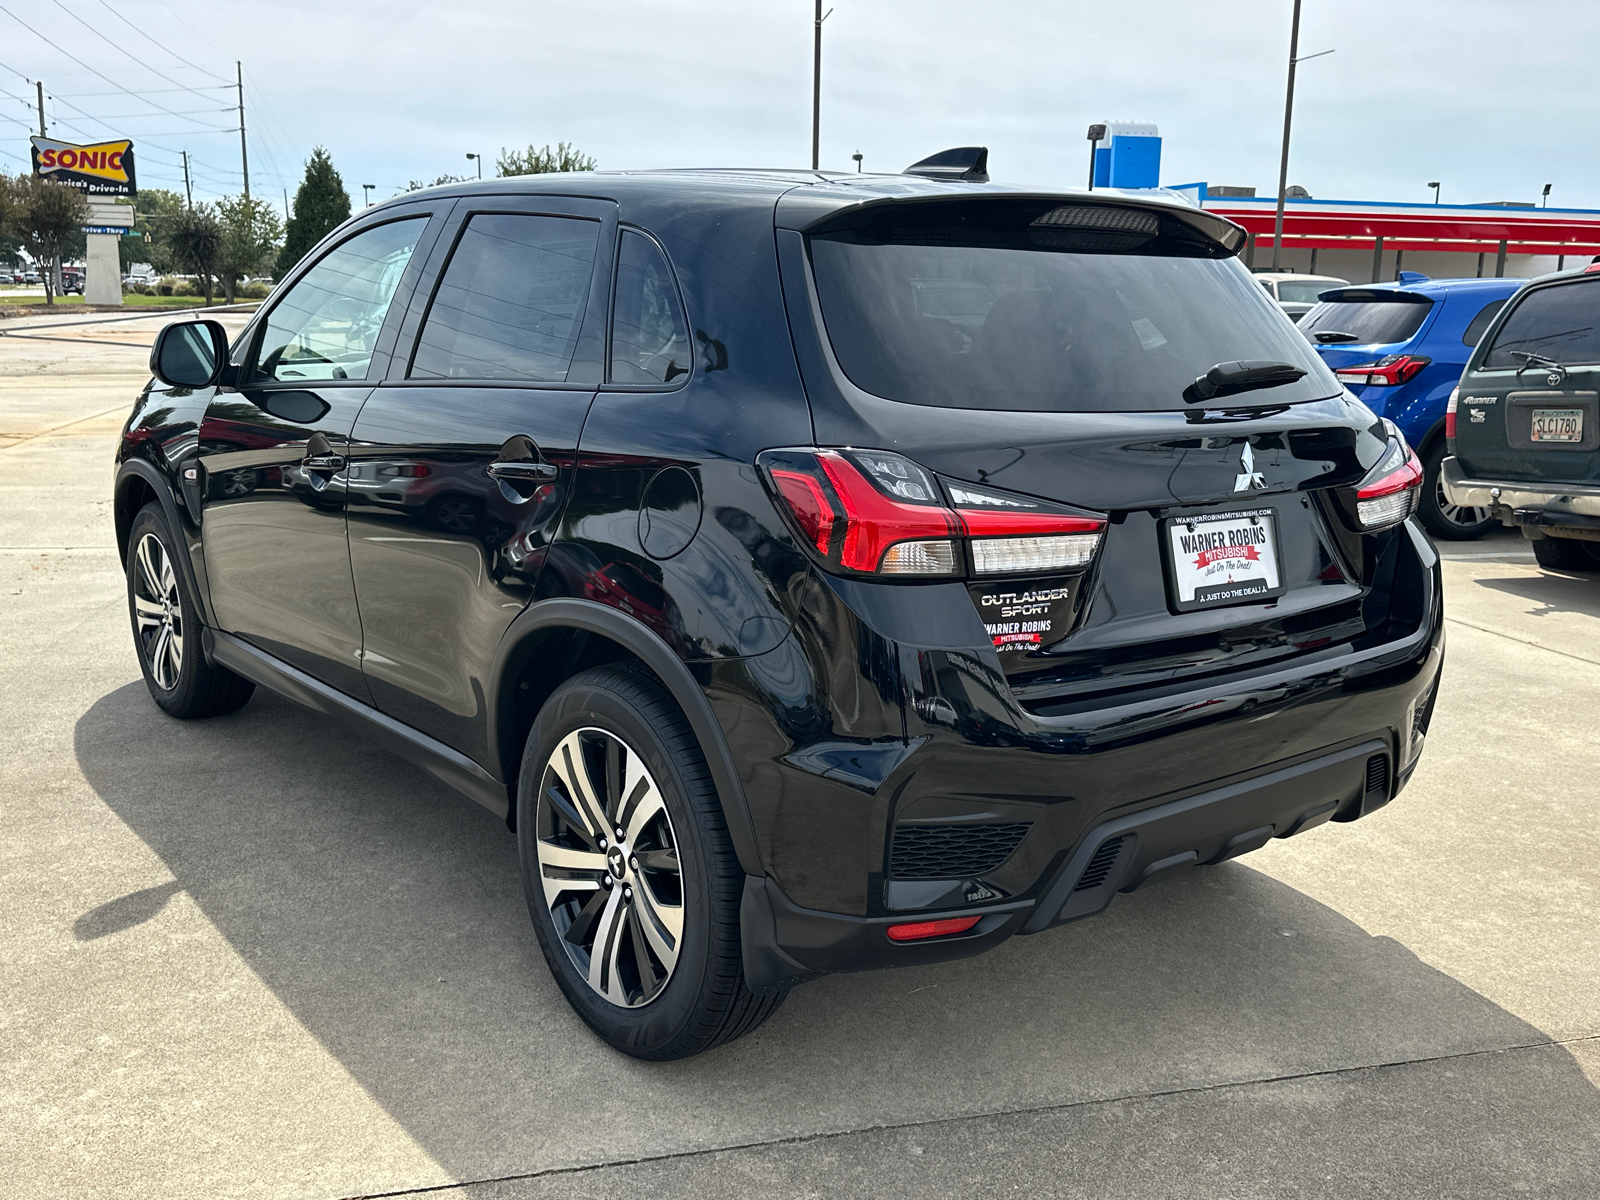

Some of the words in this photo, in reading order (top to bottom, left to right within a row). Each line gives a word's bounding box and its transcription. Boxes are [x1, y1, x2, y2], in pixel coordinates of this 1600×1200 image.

[41, 148, 124, 170] SONIC
[42, 178, 88, 188] Aerica's
[1536, 418, 1577, 434] SLC1780
[1180, 531, 1226, 554] WARNER
[1228, 526, 1266, 547] ROBINS
[1204, 546, 1249, 562] MITSUBISHI
[1205, 564, 1217, 577] Just
[1216, 562, 1225, 572] Do
[1225, 560, 1236, 570] The
[1236, 559, 1253, 570] Deal!
[981, 587, 1069, 606] OUTLANDER
[1205, 592, 1221, 602] JUST
[1221, 591, 1231, 599] DO
[1231, 589, 1244, 598] THE
[1244, 587, 1261, 595] DEAL!
[1001, 602, 1052, 618] SPORT
[984, 622, 1020, 635] WARNER
[1021, 619, 1052, 633] ROBINS
[1000, 633, 1035, 643] MITSUBISHI
[1005, 643, 1013, 651] Do
[1013, 642, 1024, 651] The
[651, 751, 701, 917] NEXEN
